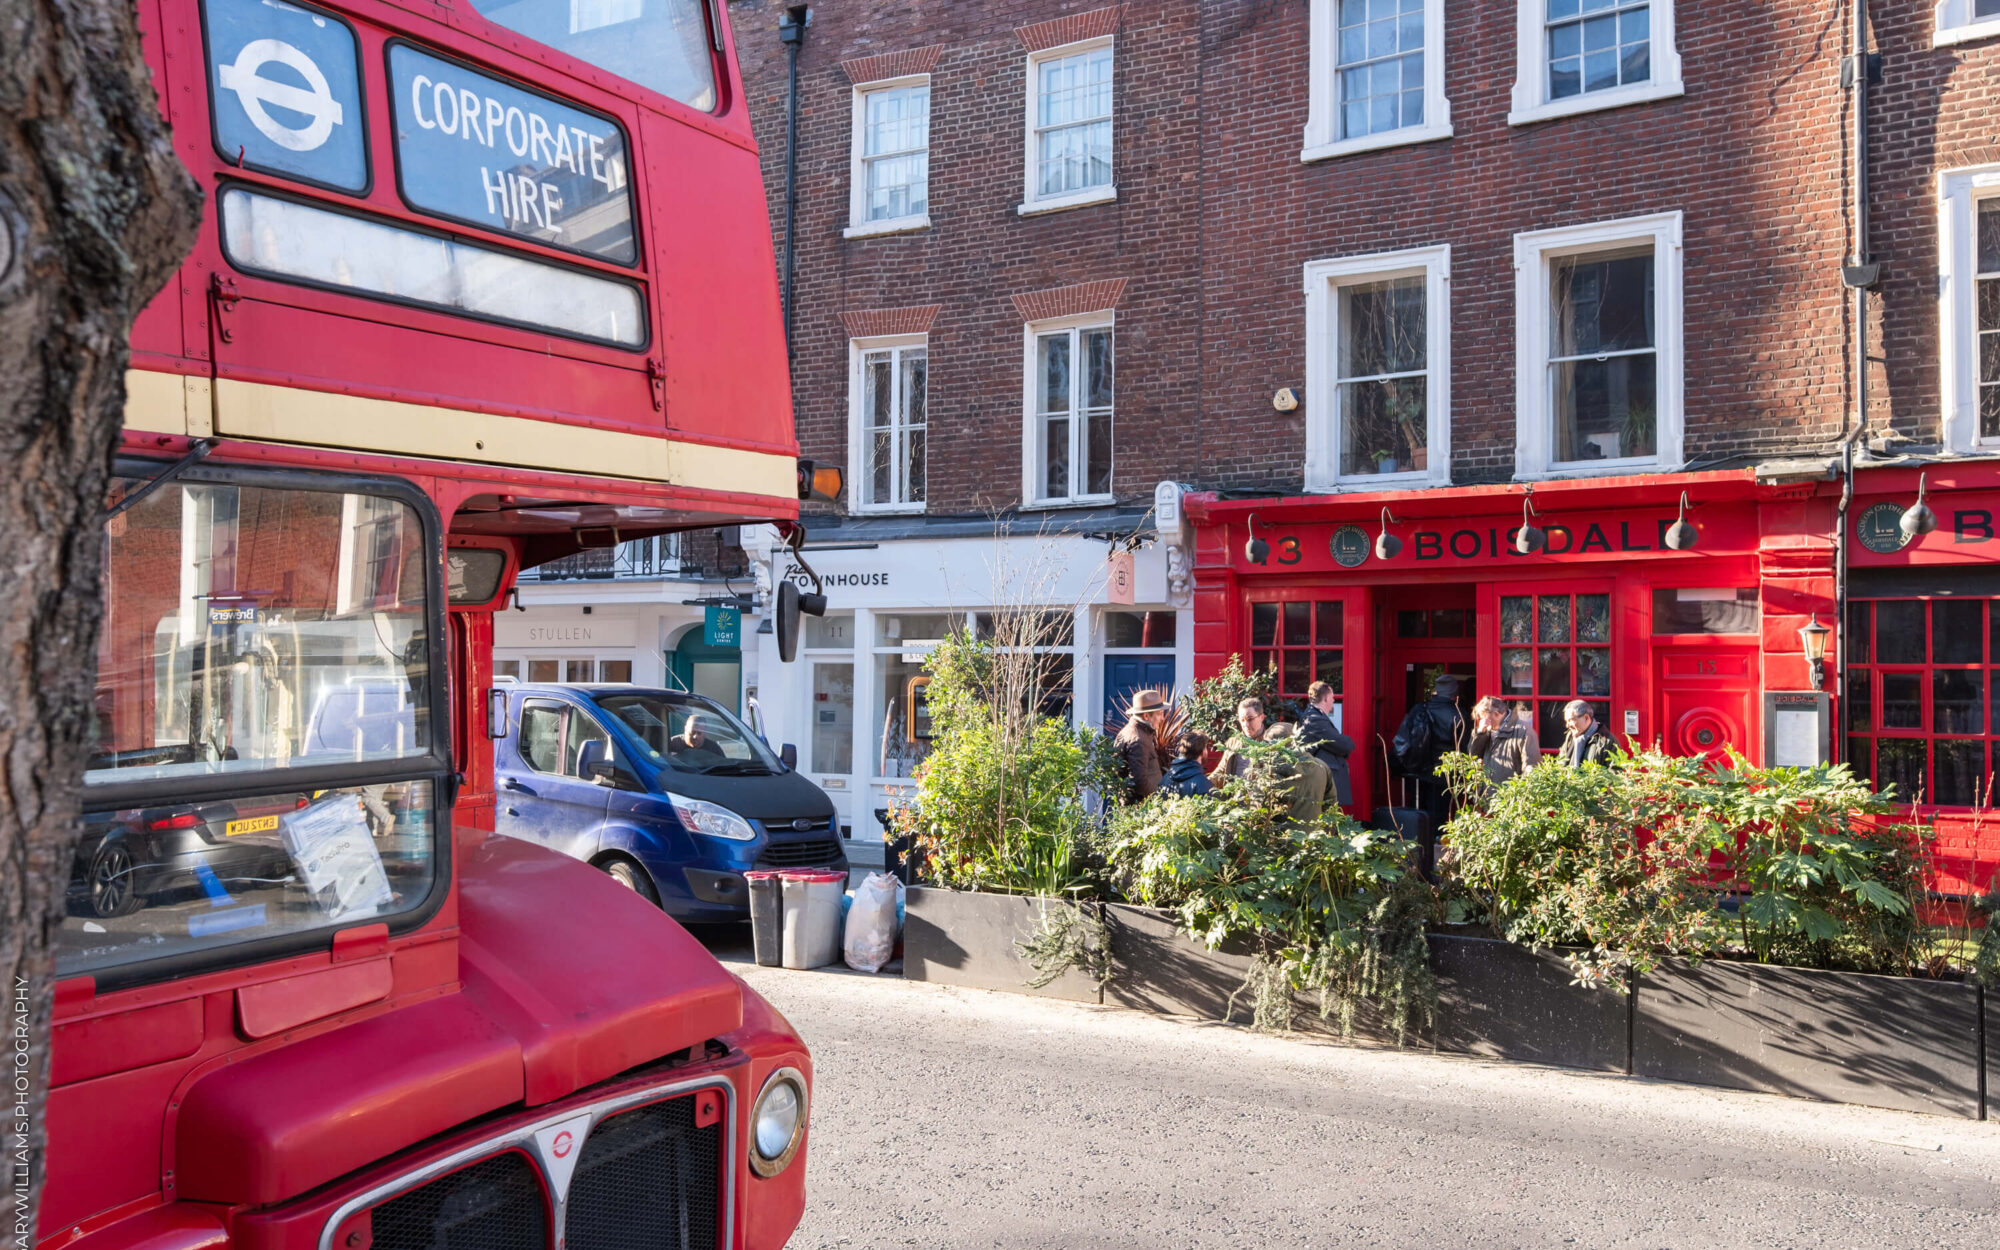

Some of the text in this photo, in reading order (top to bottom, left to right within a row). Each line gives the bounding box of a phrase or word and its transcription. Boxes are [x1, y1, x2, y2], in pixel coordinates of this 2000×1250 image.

[412, 75, 608, 184] CORPORATE
[481, 167, 562, 233] HIRE
[1953, 510, 1994, 544] B
[1260, 536, 1302, 566] 3
[530, 627, 591, 640] STULLEN
[1697, 660, 1717, 675] 13
